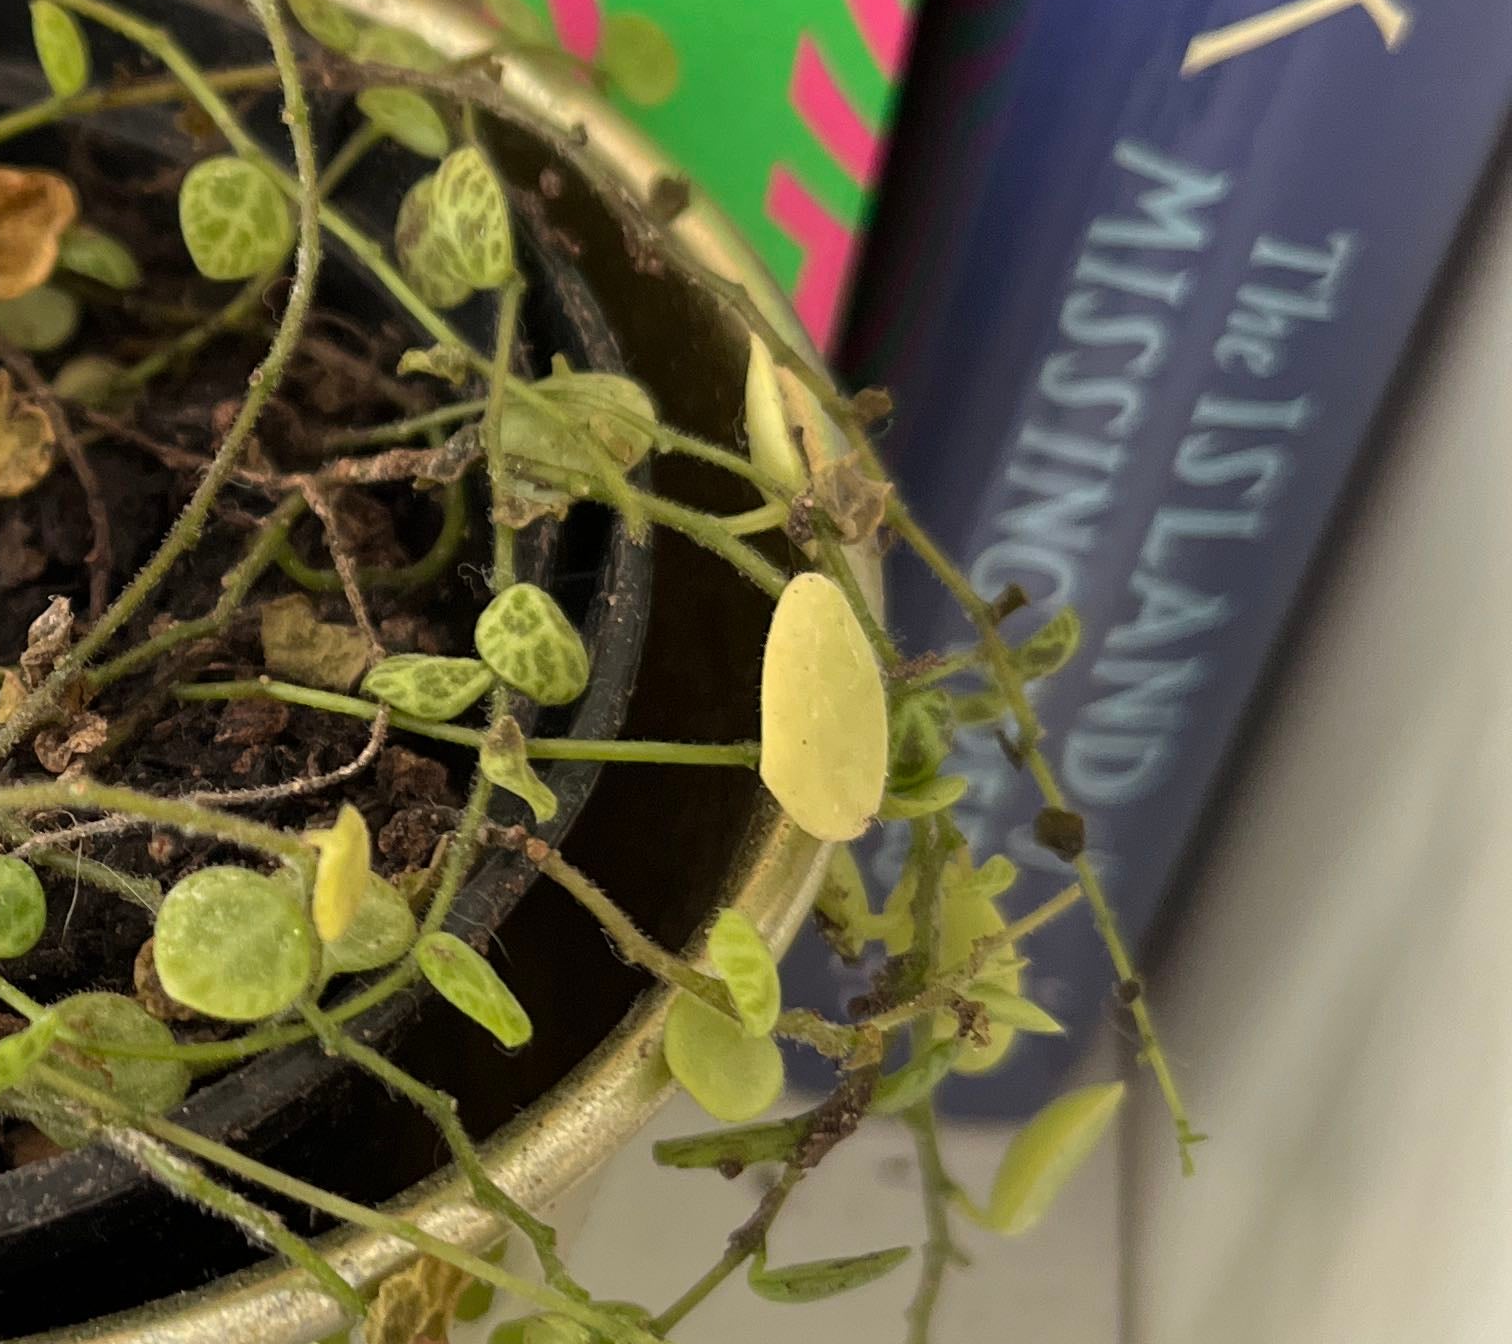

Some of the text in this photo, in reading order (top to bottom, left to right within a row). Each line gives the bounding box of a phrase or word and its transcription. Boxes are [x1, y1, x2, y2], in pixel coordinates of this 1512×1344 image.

[972, 137, 1232, 621] MISSING
[1062, 228, 1358, 806] The ISLAND
